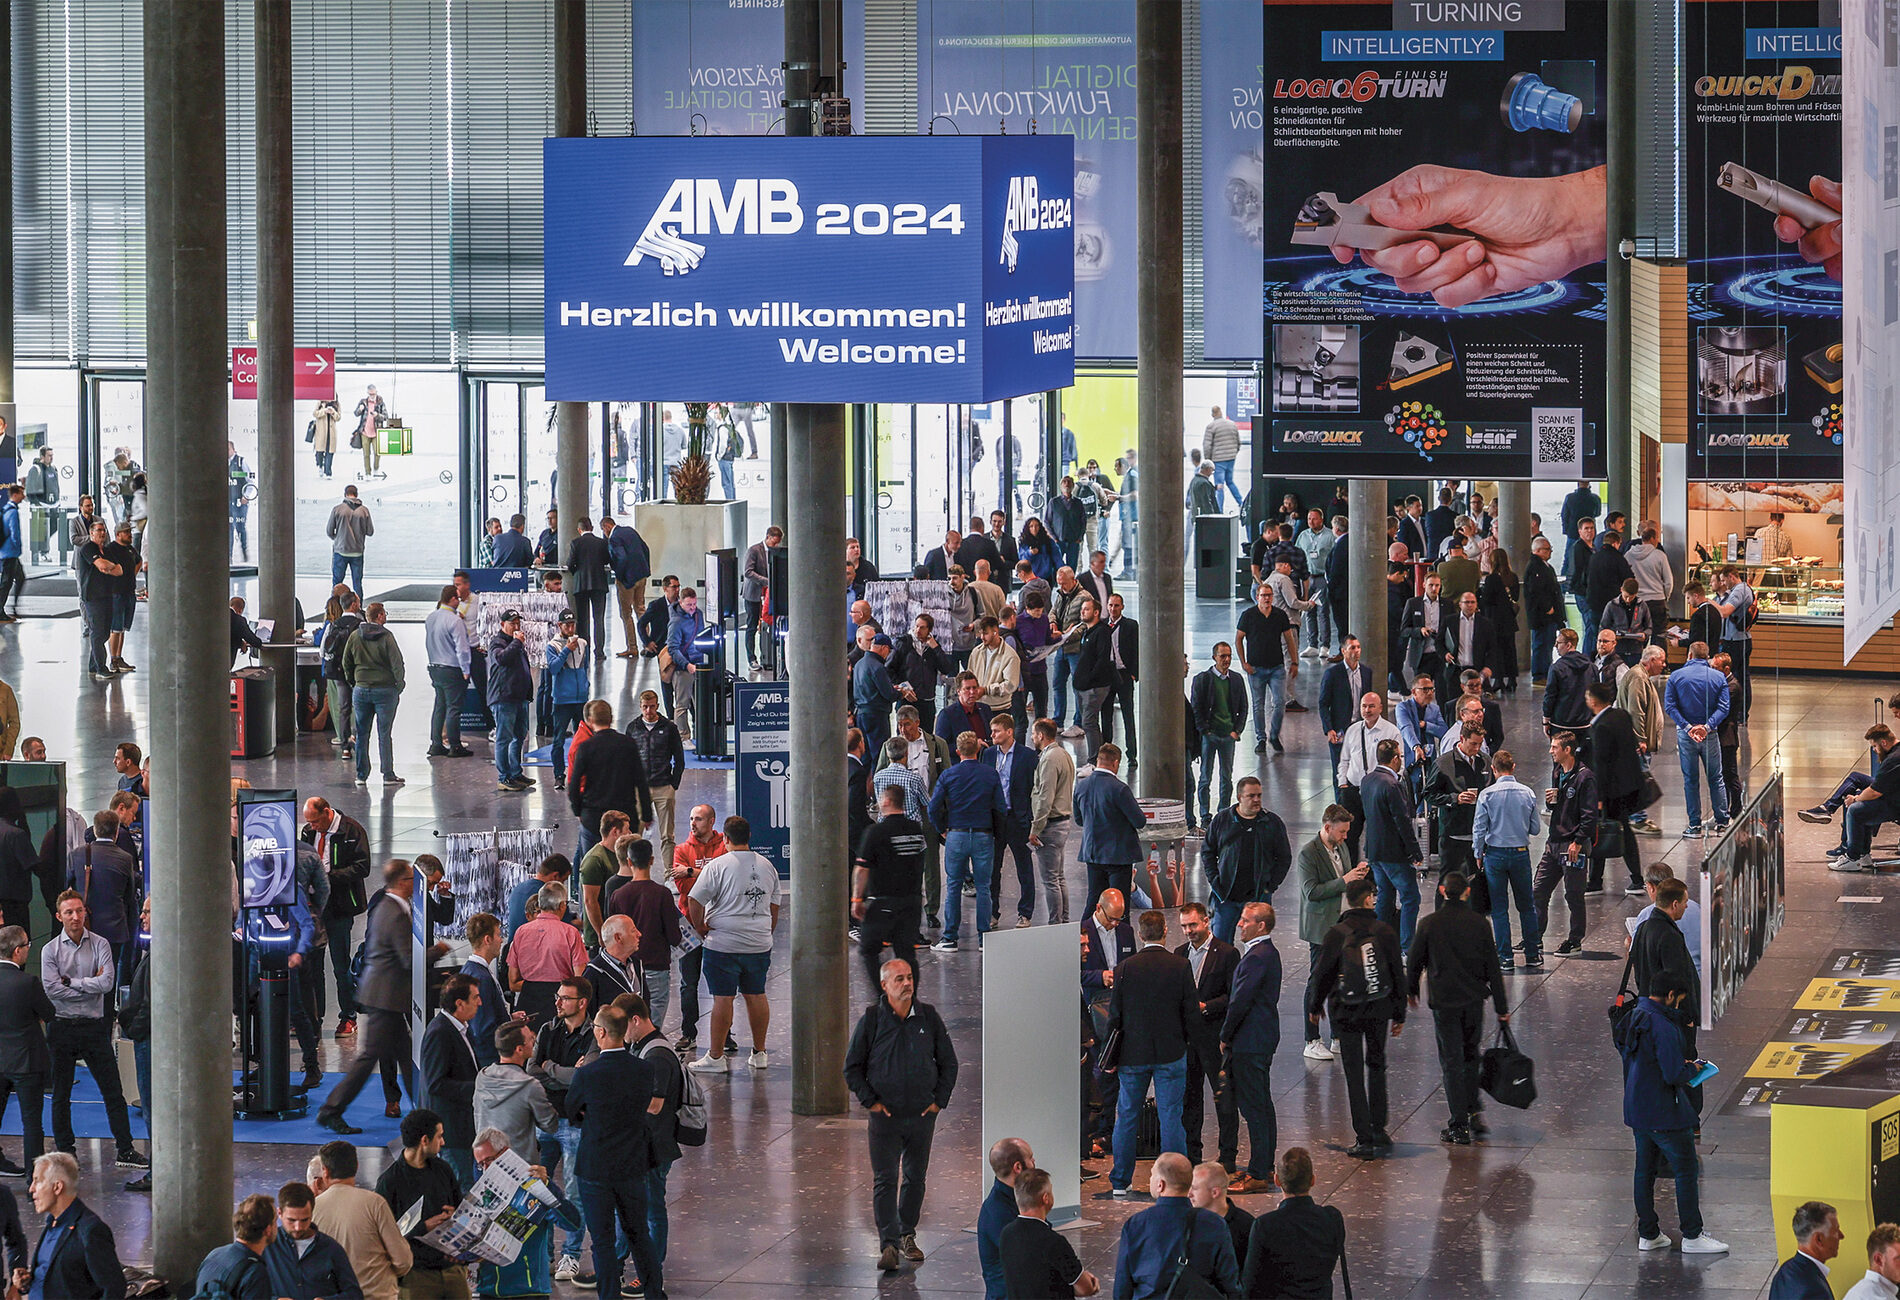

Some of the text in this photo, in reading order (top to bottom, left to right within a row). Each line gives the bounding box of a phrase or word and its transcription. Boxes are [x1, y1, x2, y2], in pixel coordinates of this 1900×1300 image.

[1410, 2, 1522, 22] TURNING
[1332, 37, 1495, 54] INTELLIGENTLY?
[1758, 35, 1842, 52] INTELLIG
[1395, 70, 1448, 78] FINISH
[1694, 66, 1842, 100] QUICKDMI
[1332, 106, 1362, 115] positive
[1697, 103, 1744, 111] Kombi-Linie
[1697, 114, 1736, 123] Werkzeug
[1273, 128, 1362, 136] Schlichtbearbeitungen
[1273, 138, 1340, 148] Oberflächengüte.
[623, 179, 966, 267] AMB 2024
[1000, 176, 1071, 265] AMB 2024
[560, 301, 966, 327] Herzlich willkommen!
[986, 291, 1072, 326] Herzlich willkommen!
[1033, 326, 1072, 354] Welcome!
[778, 338, 966, 364] Welcome!
[1538, 416, 1575, 424] SCAN ME
[1283, 430, 1364, 443] LOGIQUICK
[1708, 434, 1791, 446] LOGIQUICK
[500, 571, 522, 583] AMB
[751, 693, 782, 709] AMB
[247, 838, 278, 857] AMB
[1883, 1118, 1898, 1142] SOS
